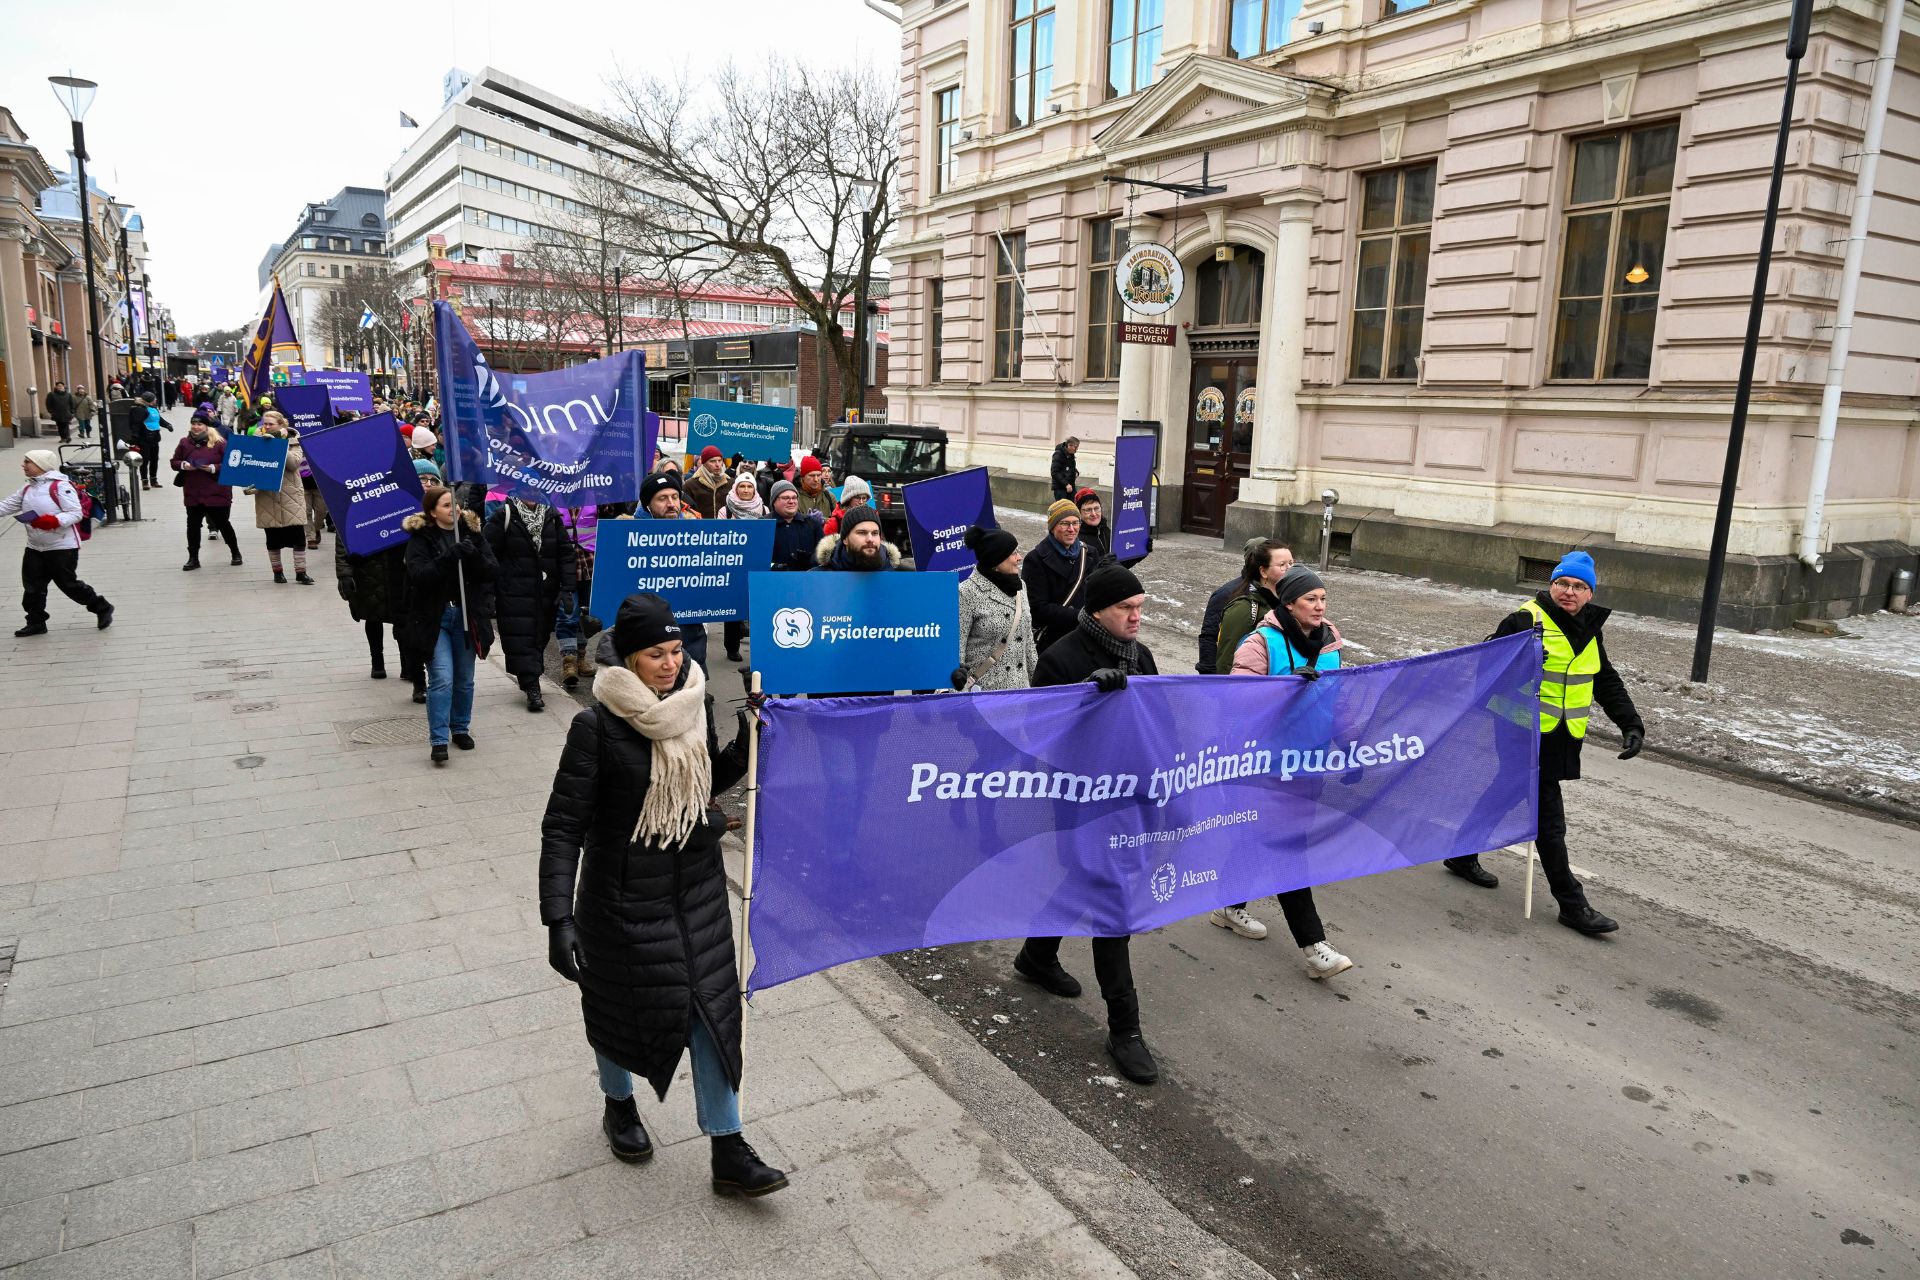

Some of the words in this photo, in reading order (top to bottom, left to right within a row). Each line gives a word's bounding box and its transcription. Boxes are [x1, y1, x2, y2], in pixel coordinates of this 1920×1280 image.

[1217, 250, 1224, 258] 18
[1125, 325, 1169, 335] BRYGGERI
[1125, 334, 1169, 343] BREWERY
[302, 420, 322, 428] repien
[720, 419, 789, 433] Terveydenhoitajaliitto
[345, 472, 385, 489] Sopien
[583, 473, 613, 488] liitto
[351, 491, 363, 503] ei
[363, 482, 399, 499] repien
[1123, 486, 1139, 498] Sopien
[1122, 501, 1128, 510] ei
[1127, 499, 1143, 511] repien
[627, 530, 748, 547] Neuvottelutaito
[933, 524, 967, 539] Sopien
[935, 542, 945, 553] ei
[627, 554, 647, 569] on
[650, 551, 743, 568] suomalainen
[637, 572, 730, 592] supervoima!
[822, 615, 853, 623] SUOMEN
[820, 622, 941, 644] Fysioterapeutit
[907, 762, 1139, 803] Paremman
[1147, 739, 1271, 808] työelämän
[1280, 733, 1425, 782] puolesta
[1109, 809, 1258, 849] #ParemmanTyöelämänPuolesta
[1180, 867, 1218, 888] Akava
